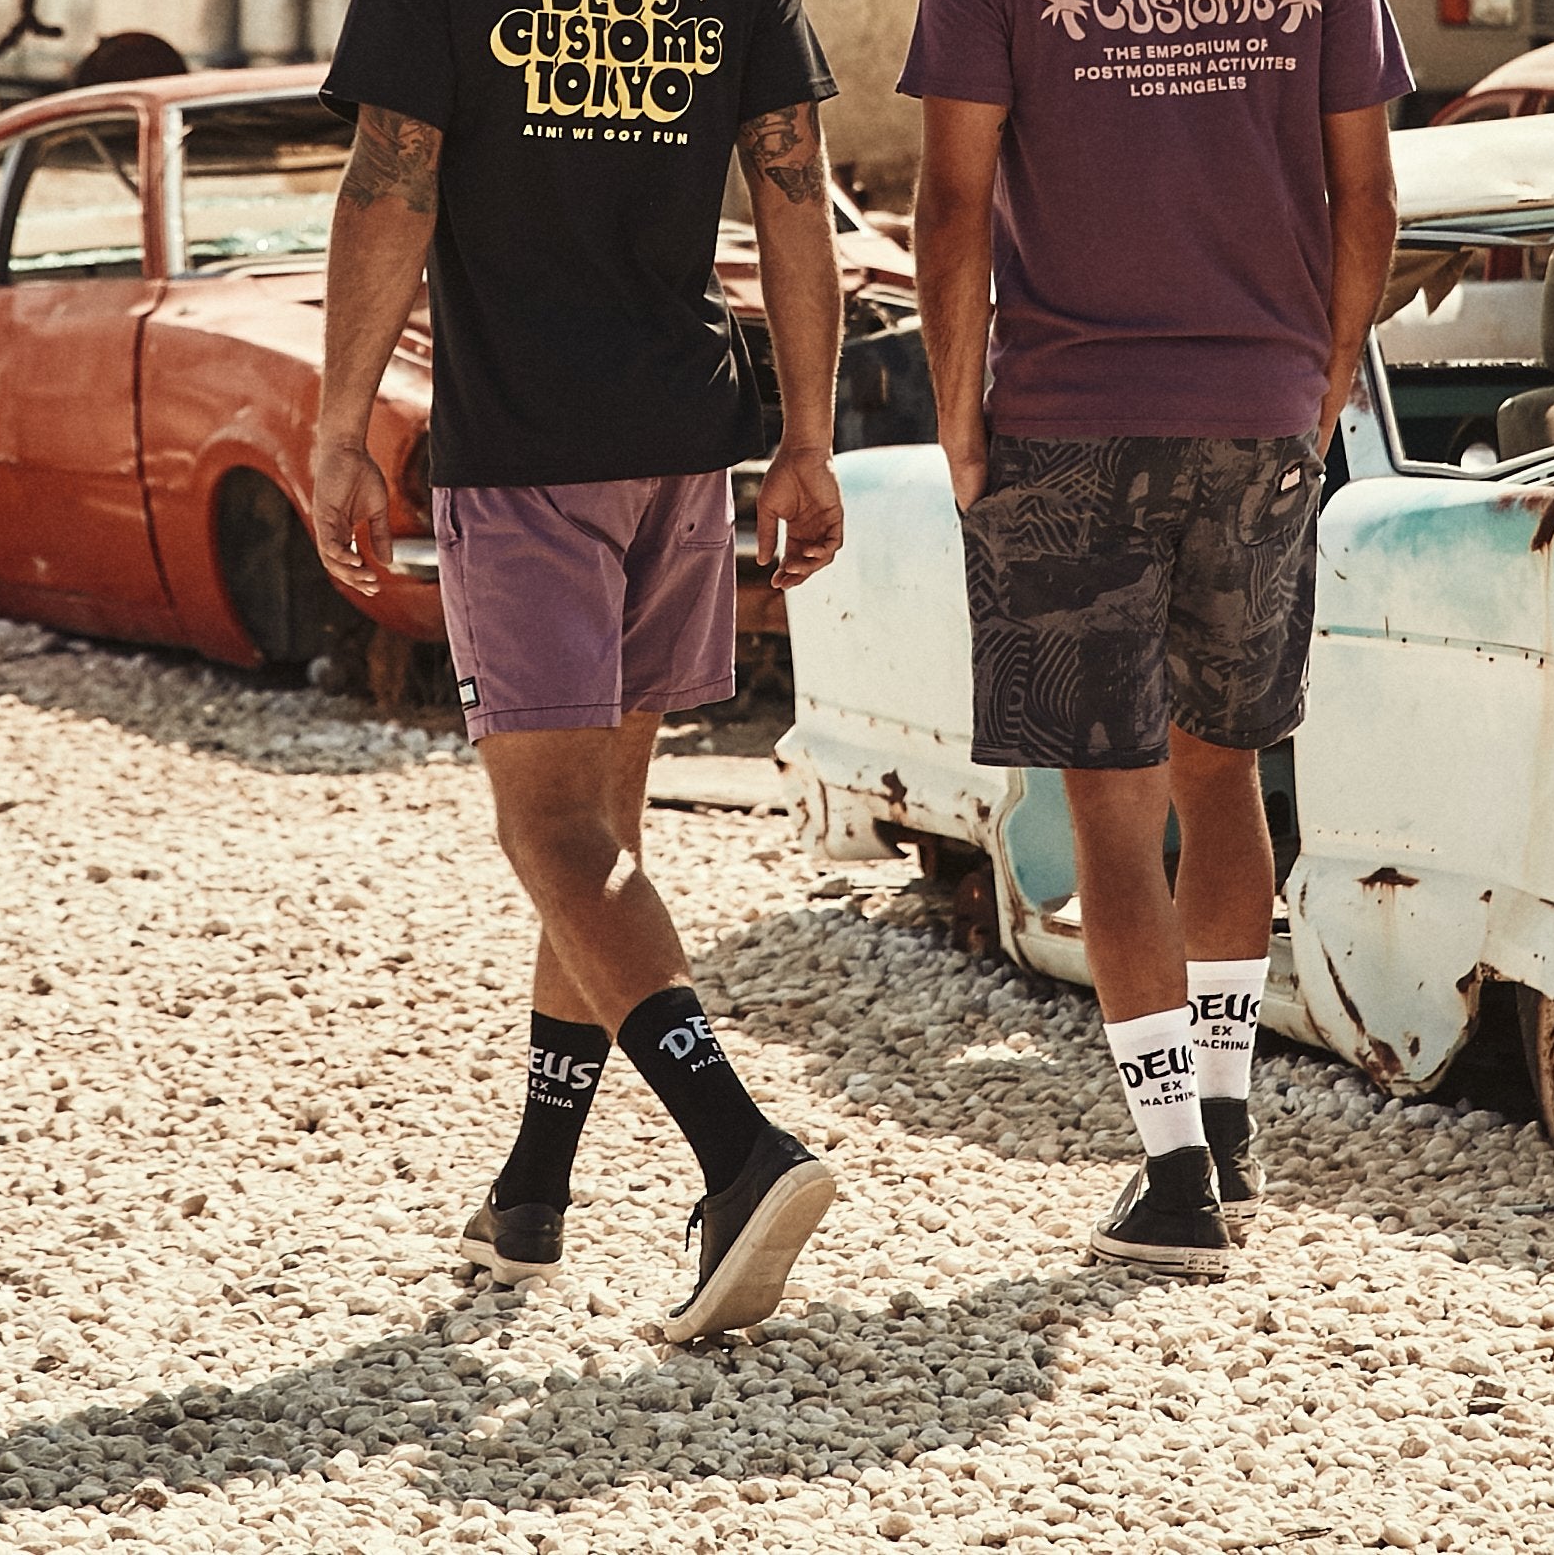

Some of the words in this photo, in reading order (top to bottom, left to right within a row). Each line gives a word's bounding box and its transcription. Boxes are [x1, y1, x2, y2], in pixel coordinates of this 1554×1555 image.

[490, 8, 724, 75] CUSTOMS
[1103, 47, 1141, 61] THE
[1146, 39, 1240, 59] EMPORIUM
[1246, 38, 1269, 53] OF
[1074, 59, 1202, 80] POSTMODERN
[1206, 56, 1296, 74] ACTIVITES
[1130, 82, 1165, 97] LOS
[1169, 75, 1247, 95] ANGELES
[603, 129, 642, 142] GOT
[652, 131, 688, 145] FUN
[659, 1016, 714, 1059] DE
[1211, 1025, 1233, 1036] EX
[529, 1046, 600, 1090] EUS
[531, 1078, 549, 1091] EX
[1161, 1080, 1182, 1093] EX
[530, 1090, 574, 1109] CHINA
